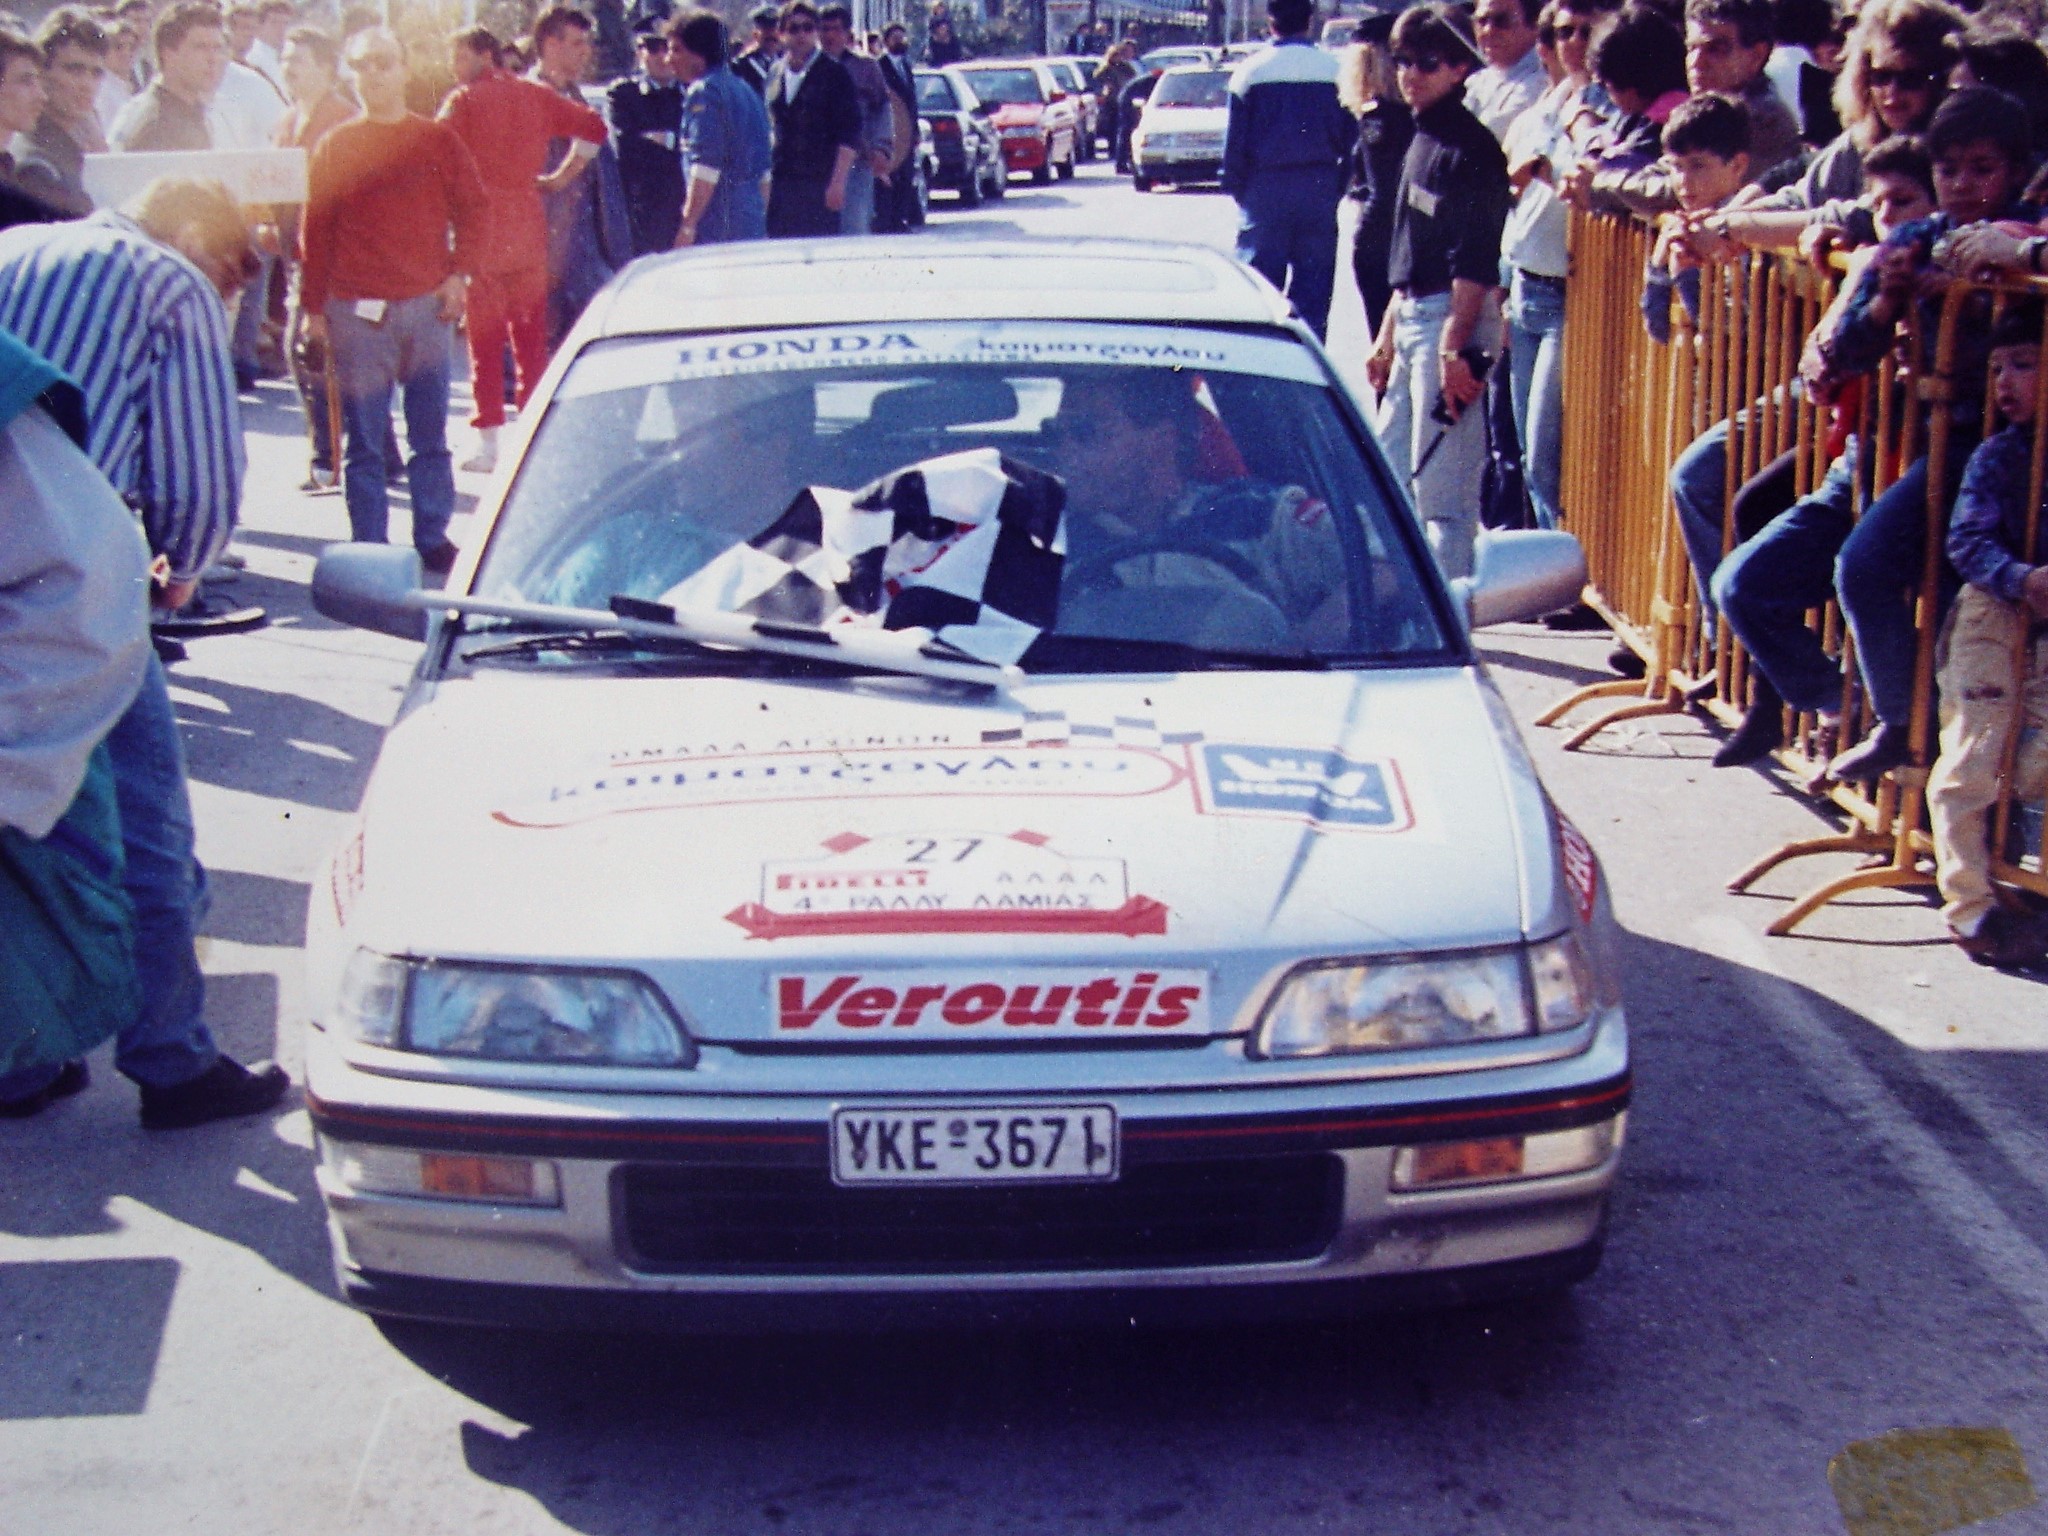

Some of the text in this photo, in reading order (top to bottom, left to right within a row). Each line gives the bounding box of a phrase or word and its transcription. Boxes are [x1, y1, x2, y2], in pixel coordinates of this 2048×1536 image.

[679, 333, 919, 365] HONDA
[905, 837, 982, 862] 27
[777, 972, 1201, 1029] Veroutis
